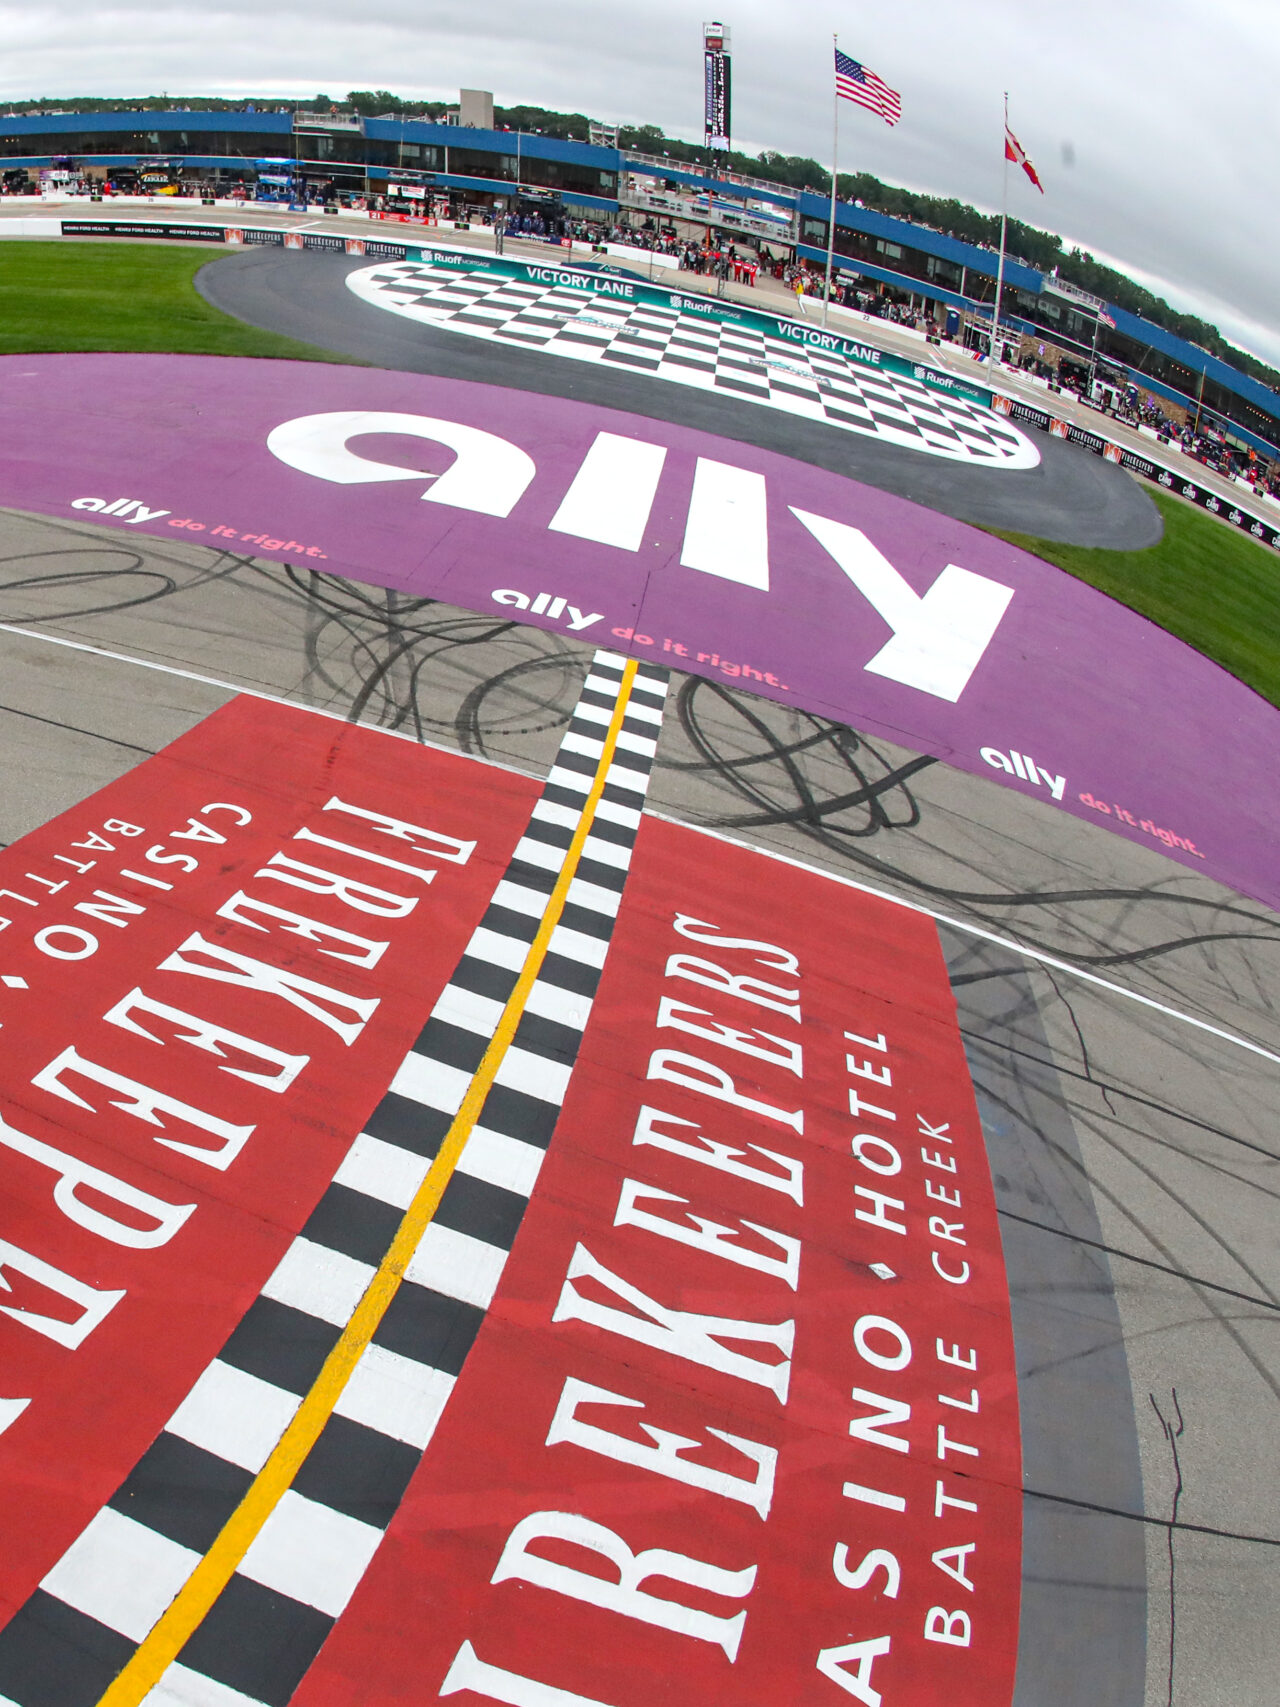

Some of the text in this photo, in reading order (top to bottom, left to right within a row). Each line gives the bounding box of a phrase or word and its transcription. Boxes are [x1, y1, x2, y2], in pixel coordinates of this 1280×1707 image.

[434, 252, 462, 265] Ruoff
[526, 266, 634, 297] VICTORY LANE
[684, 299, 713, 314] Ruoff
[777, 322, 881, 364] VICTORY LANE
[926, 371, 953, 388] Ruoff
[71, 496, 328, 560] ally do it right.
[267, 411, 1015, 703] ally
[490, 588, 789, 691] ally do it right.
[979, 746, 1206, 860] ally do it right.
[33, 801, 253, 961] CASINO
[438, 911, 804, 1707] IREKEEPERS
[816, 1032, 913, 1707] ASINO HOTEL
[916, 1112, 980, 1648] BATTLE CREEK
